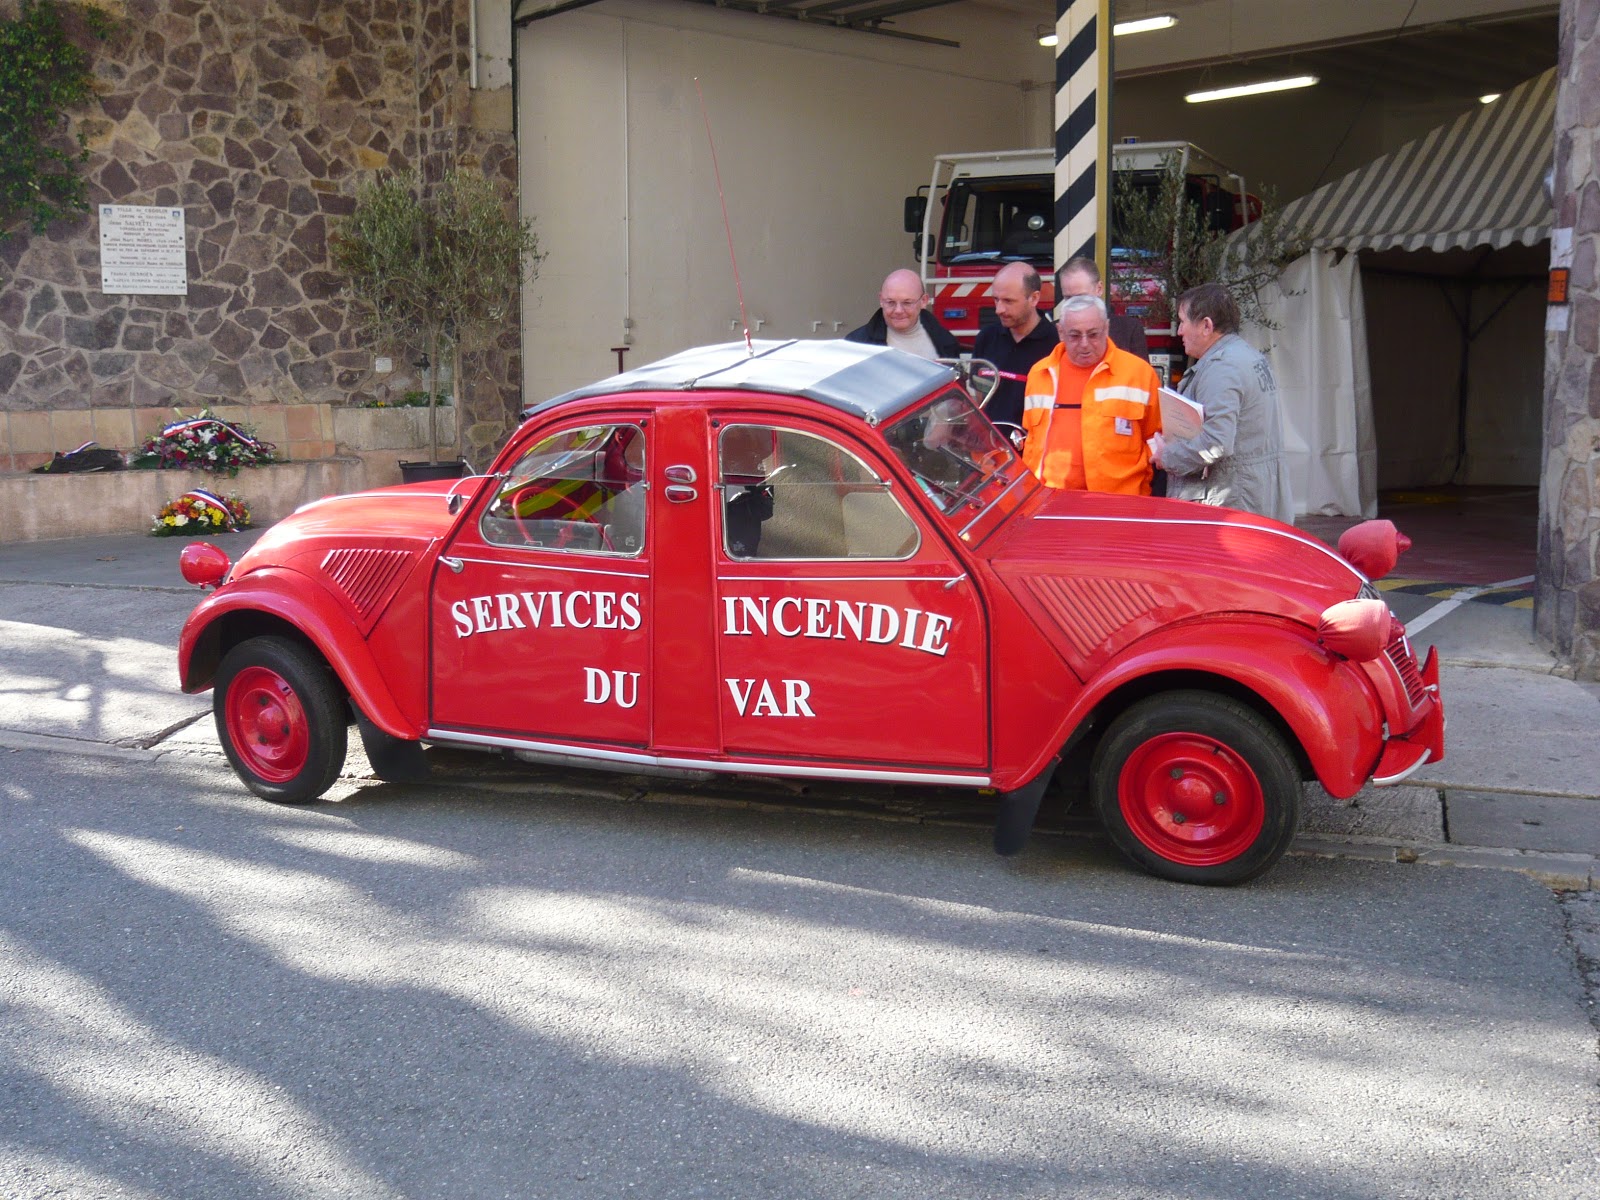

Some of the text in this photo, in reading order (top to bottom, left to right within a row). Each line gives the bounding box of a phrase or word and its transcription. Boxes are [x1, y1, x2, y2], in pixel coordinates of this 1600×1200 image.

[452, 591, 952, 655] SERVICES INCENDIE
[584, 667, 815, 716] DU VAR
